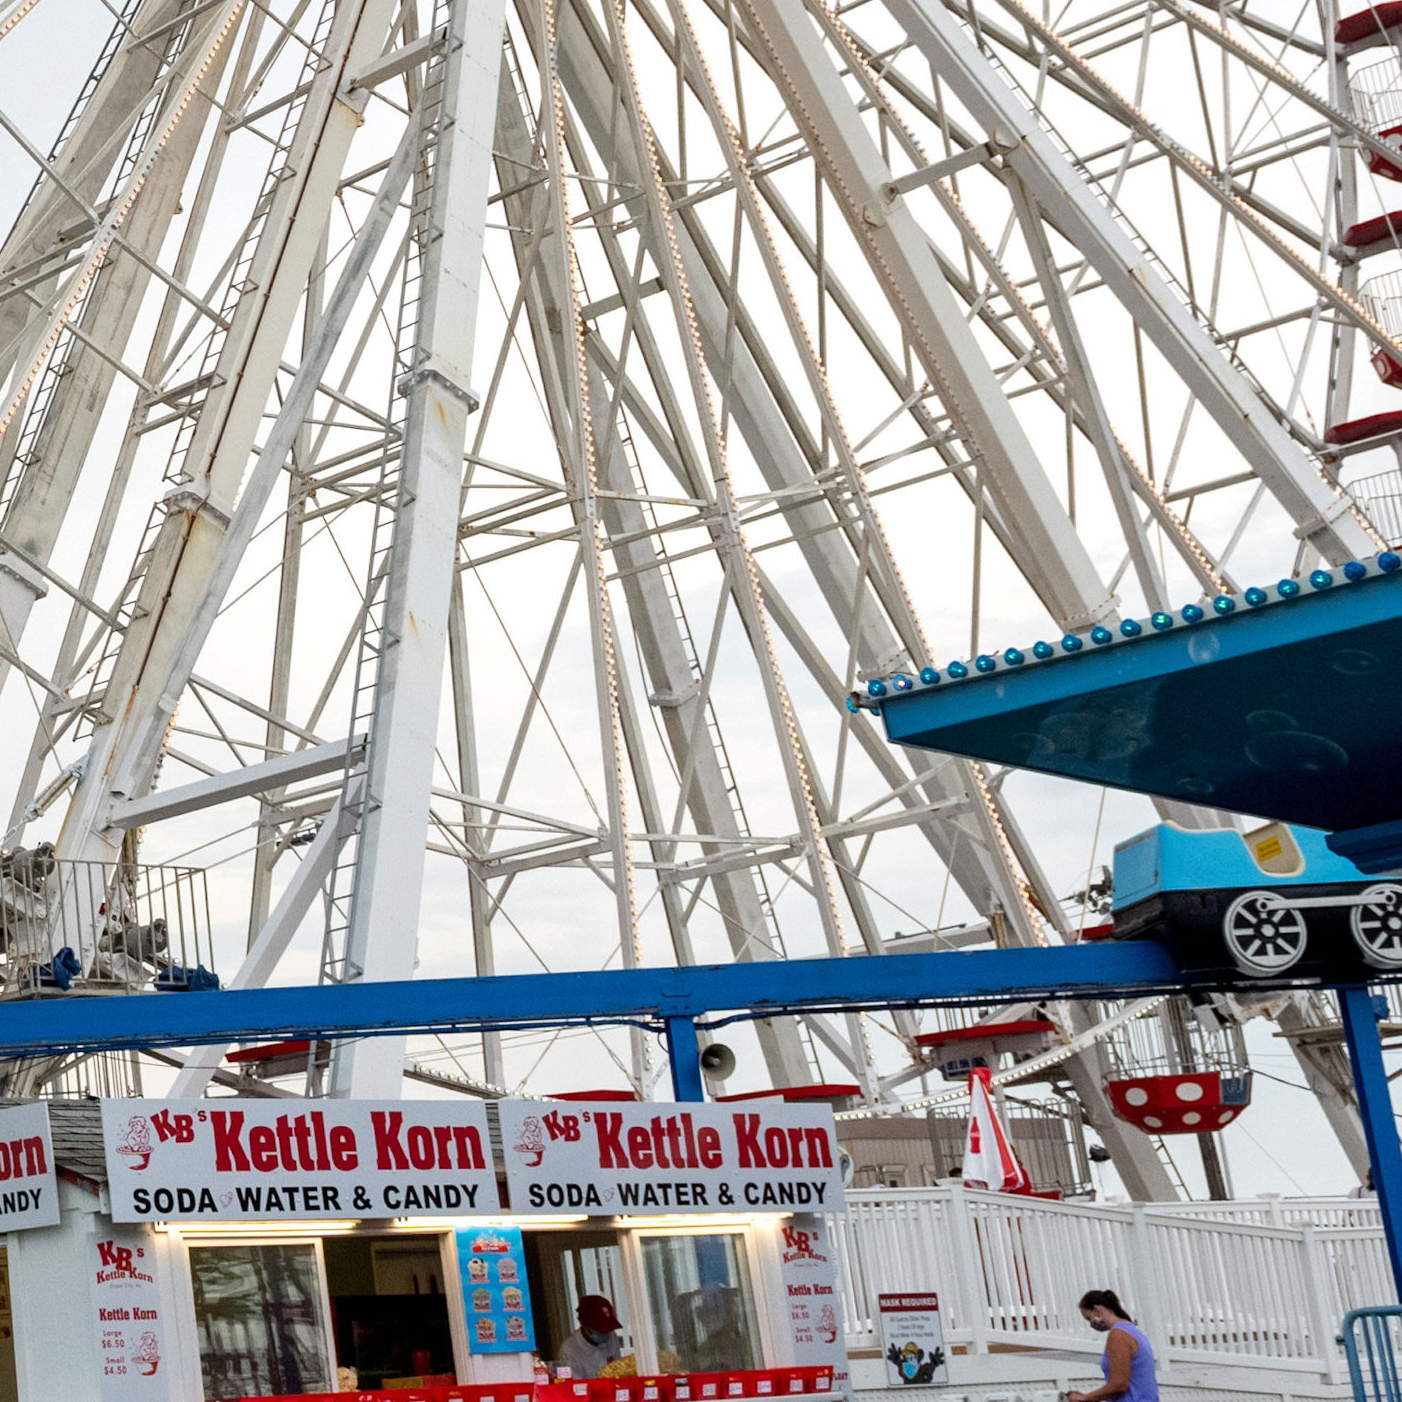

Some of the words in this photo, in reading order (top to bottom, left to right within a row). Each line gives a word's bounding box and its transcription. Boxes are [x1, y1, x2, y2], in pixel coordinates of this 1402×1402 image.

[210, 1111, 359, 1172] Kettle
[370, 1111, 486, 1170] Korn
[593, 1112, 723, 1169] Kettle
[732, 1113, 833, 1169] Korn
[133, 1188, 218, 1214] SODA
[235, 1186, 342, 1212] WATER
[352, 1185, 372, 1211] &
[383, 1184, 478, 1210] CANDY
[529, 1183, 602, 1208] SODA
[617, 1182, 709, 1206] WATER
[718, 1182, 735, 1206] &
[744, 1182, 826, 1205] CANDY
[808, 1248, 828, 1262] Korn
[97, 1269, 126, 1284] Kettle
[129, 1266, 154, 1283] Korn
[787, 1283, 812, 1297] Kettle
[813, 1283, 833, 1296] Korn
[880, 1298, 901, 1307] MASK
[902, 1297, 937, 1306] REQUIRED
[99, 1307, 130, 1321] Kettle
[133, 1307, 158, 1321] Korn
[101, 1339, 125, 1349] $6.50
[106, 1356, 125, 1364] Small
[104, 1366, 127, 1375] $4.50
